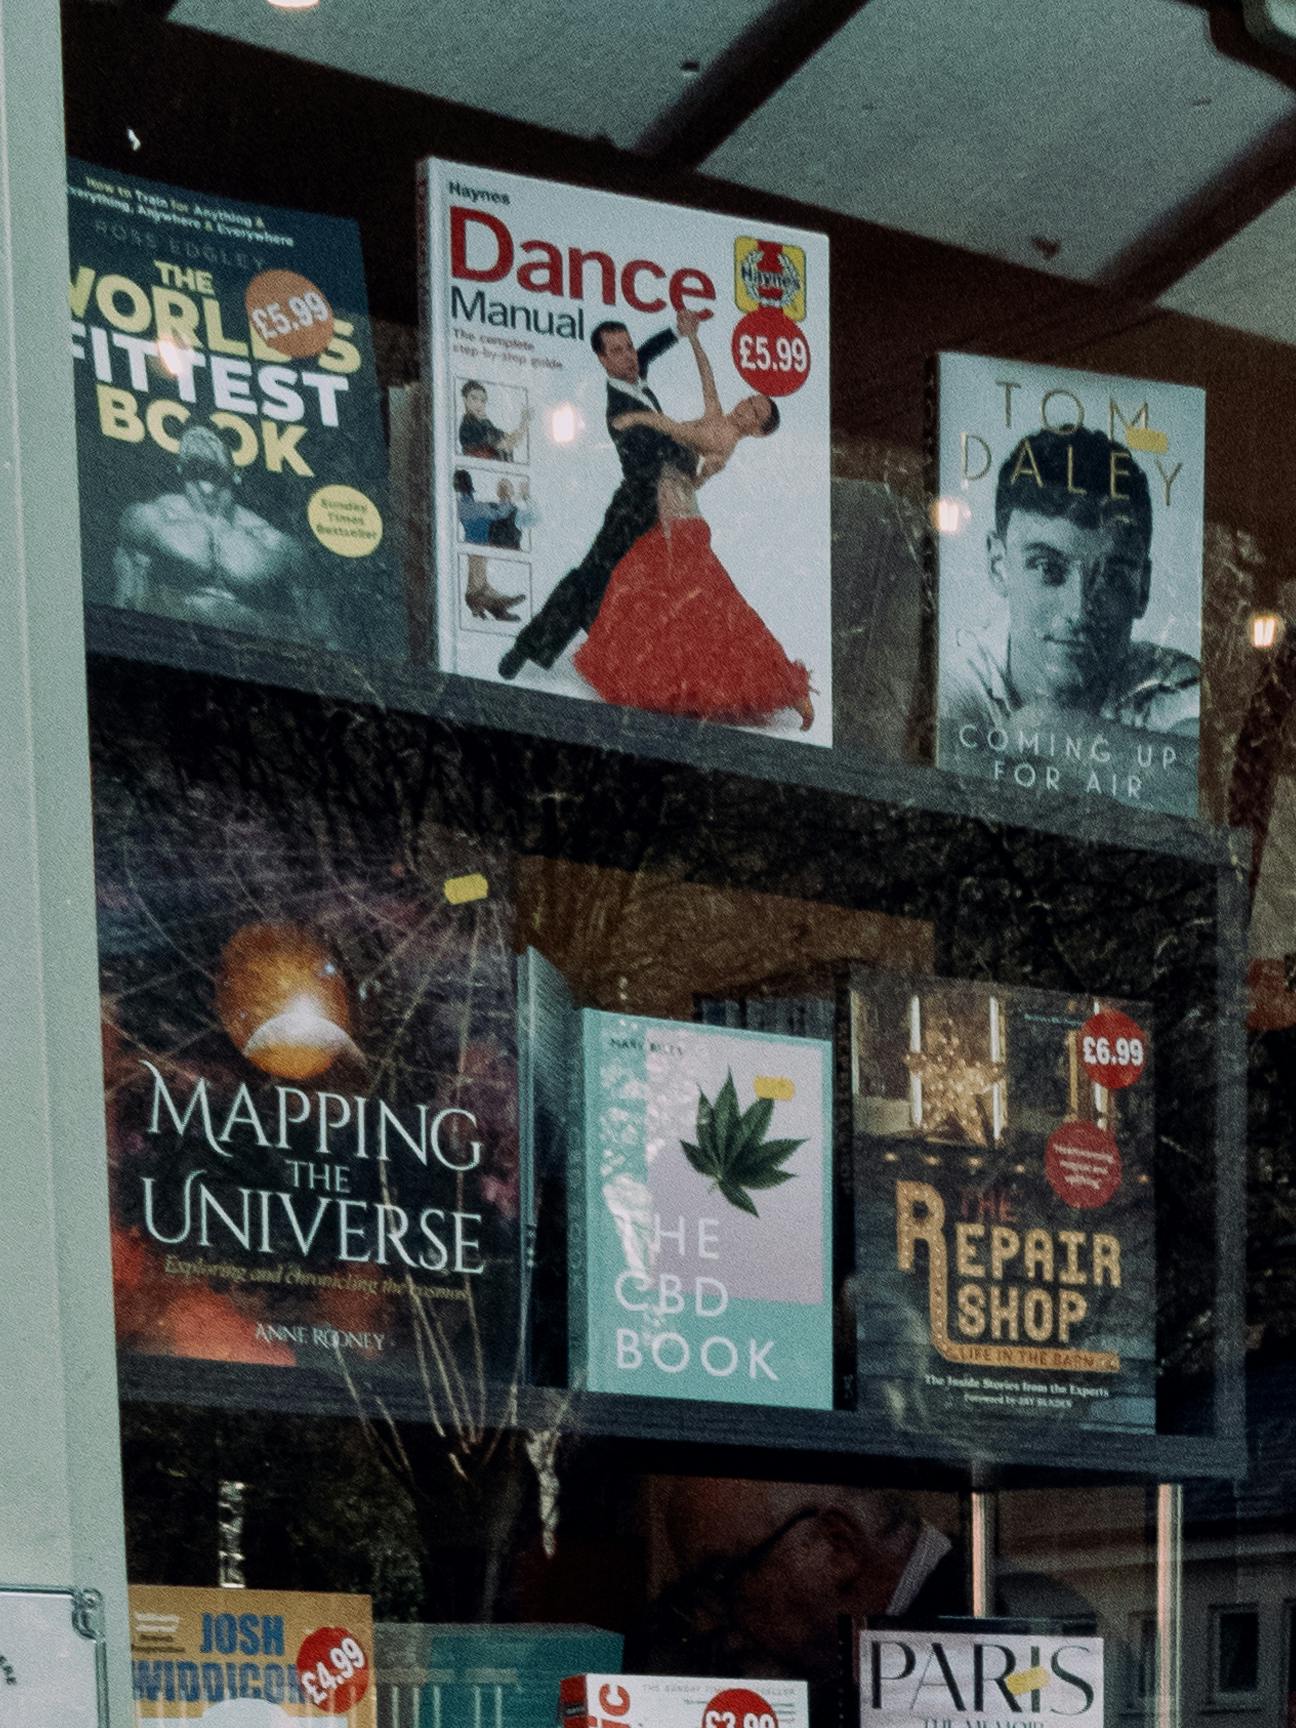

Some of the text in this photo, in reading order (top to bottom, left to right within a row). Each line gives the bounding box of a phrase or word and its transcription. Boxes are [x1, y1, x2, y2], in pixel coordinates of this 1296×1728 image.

[67, 185, 133, 214] verything,
[137, 204, 201, 229] Anywhere
[217, 223, 294, 248] Everywhere
[134, 190, 168, 208] Train
[194, 203, 252, 228] Anything
[448, 181, 511, 206] Haynes
[154, 259, 215, 295] THE
[450, 205, 716, 321] Dance
[252, 290, 330, 342] £5.99
[450, 285, 585, 341] Manual
[740, 333, 808, 374] £5.99
[996, 381, 1149, 443] TOM
[960, 432, 1182, 507] DALEY
[959, 724, 1178, 770] COMING UP
[994, 760, 1143, 800] FOR AIR
[1082, 1036, 1143, 1067] £6.99
[141, 1060, 481, 1170] MAPPING
[285, 1160, 350, 1193] THE
[142, 1170, 485, 1274] UNIVERSE
[897, 1180, 1122, 1289] REPAIR
[615, 1271, 728, 1317] CBD
[956, 1283, 1088, 1343] SHOP
[256, 1323, 304, 1344] ANNE
[616, 1328, 779, 1382] BOOK
[199, 1612, 285, 1656] JOSH
[302, 1637, 365, 1705] £4.99
[870, 1640, 1095, 1714] PARIS
